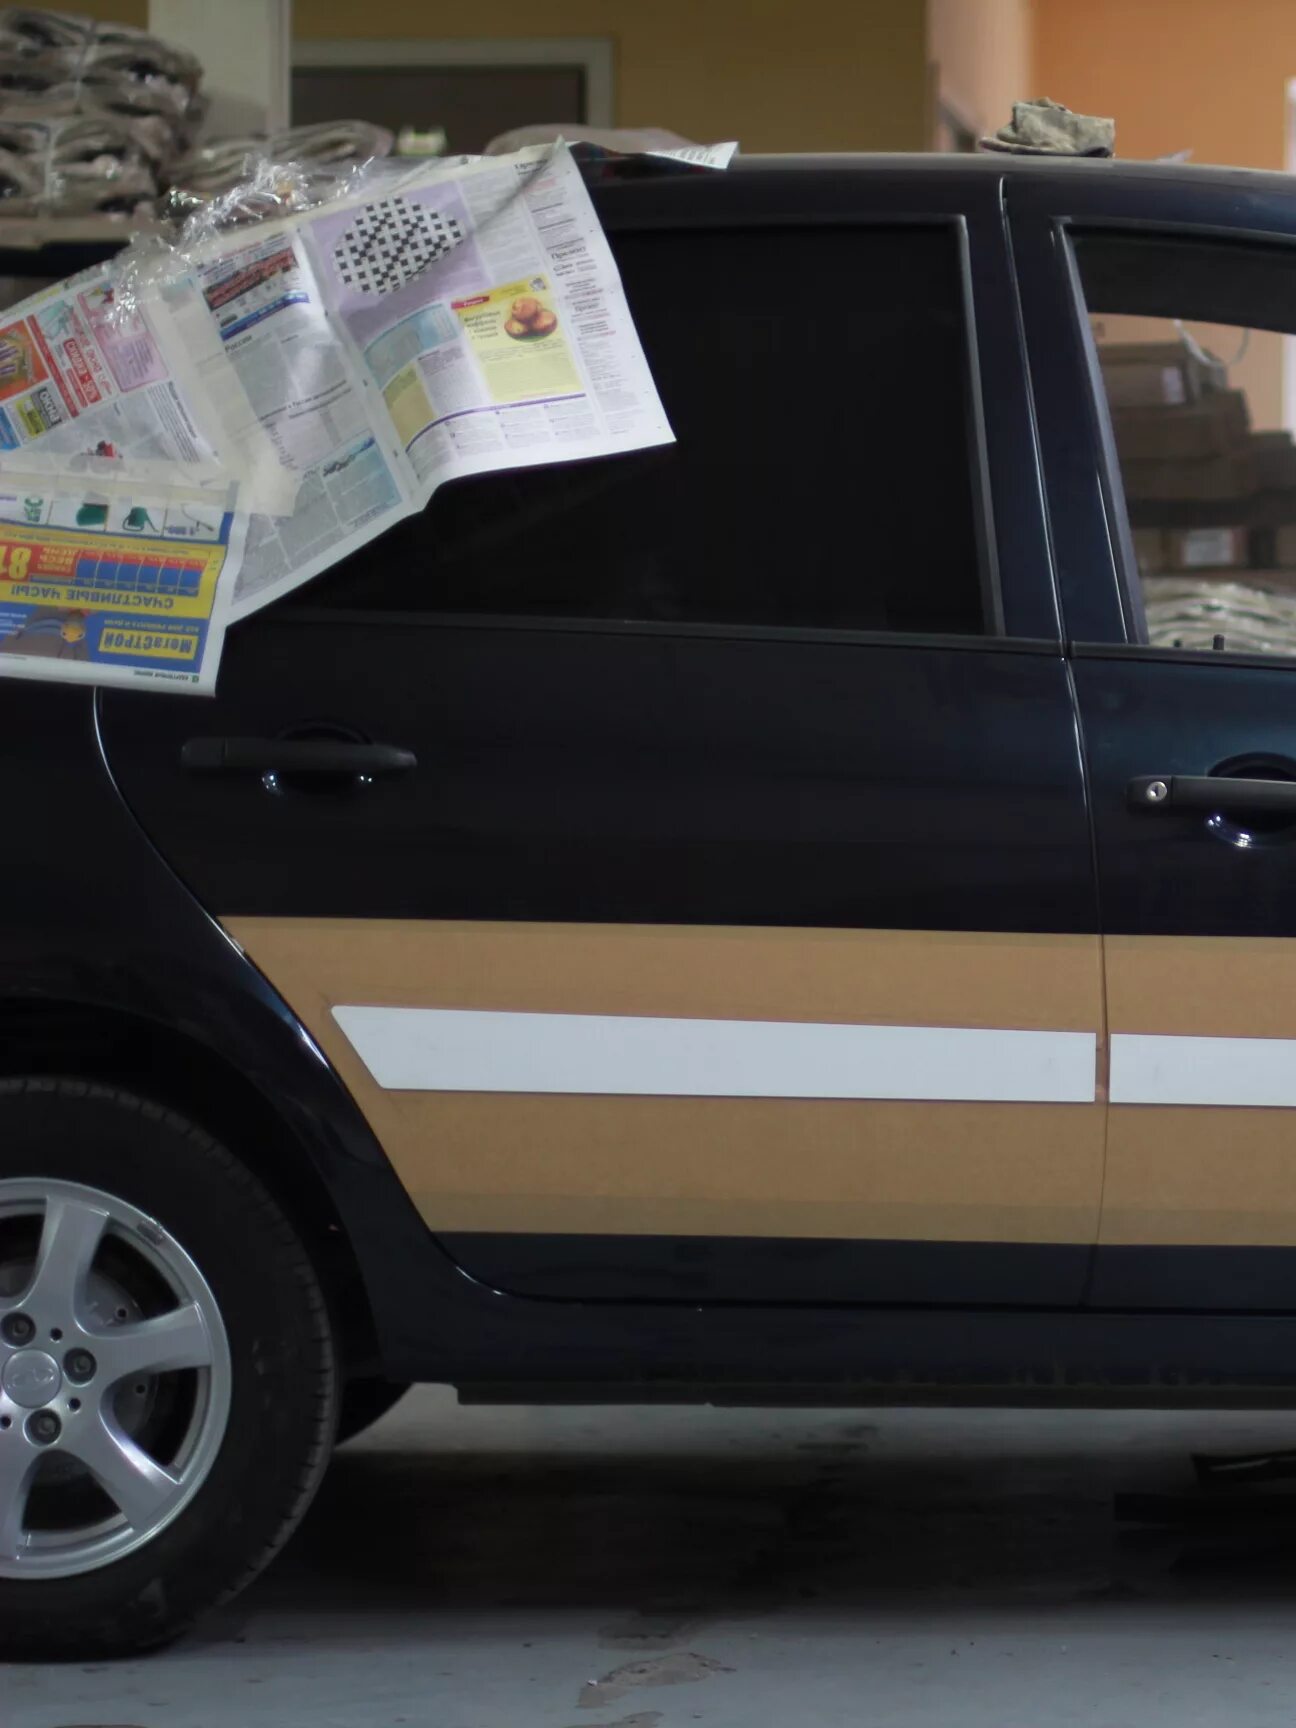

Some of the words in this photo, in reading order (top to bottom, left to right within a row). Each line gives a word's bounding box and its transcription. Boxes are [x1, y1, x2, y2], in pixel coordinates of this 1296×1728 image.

[11, 583, 61, 600] ЧАСЫ!
[66, 588, 174, 610] СЧАСТЛИВЫЕ
[103, 631, 193, 654] МегаСТРОЙ
